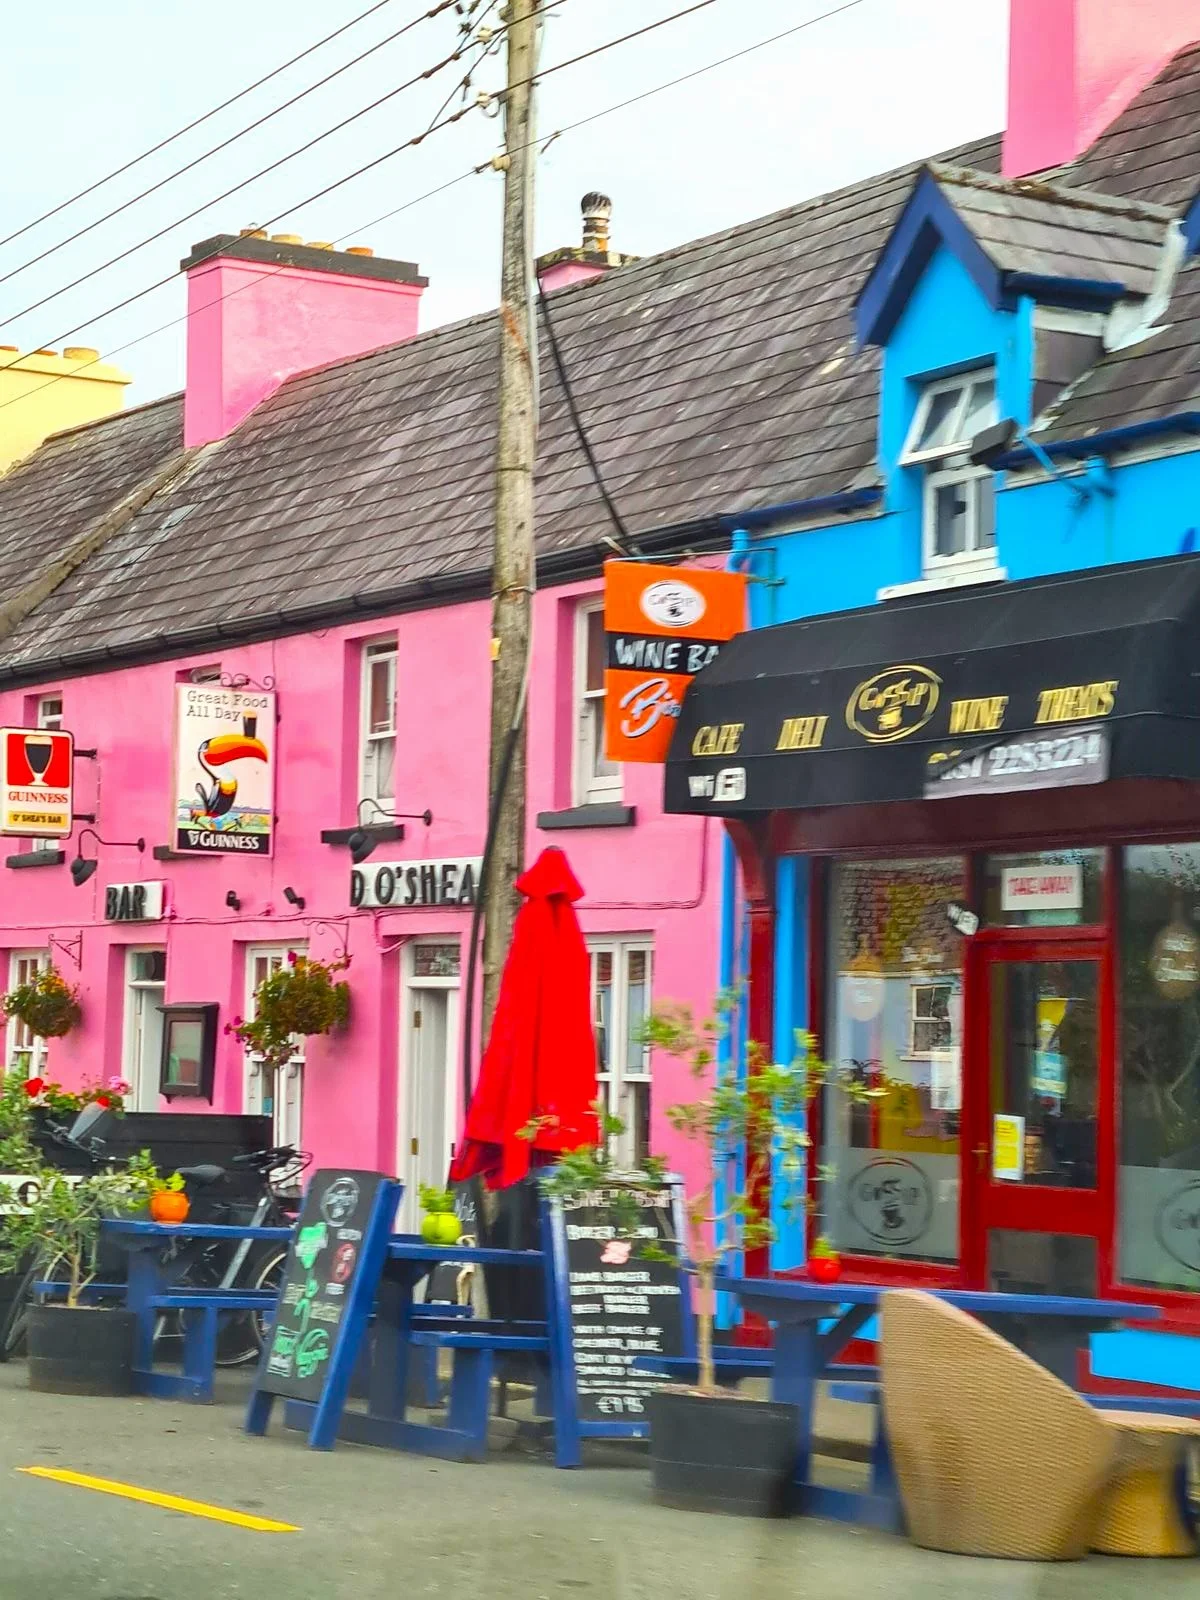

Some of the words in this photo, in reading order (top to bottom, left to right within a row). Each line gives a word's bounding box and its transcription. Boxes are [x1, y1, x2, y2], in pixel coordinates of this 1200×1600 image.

[615, 638, 681, 669] WINE
[687, 645, 719, 673] BA
[187, 690, 229, 704] Great
[233, 693, 268, 709] Food
[186, 705, 209, 718] All
[215, 708, 240, 722] Day
[692, 723, 745, 757] CAFE
[8, 791, 69, 804] GUINNESS
[200, 831, 259, 850] GUINNESS
[105, 885, 147, 920] BAR
